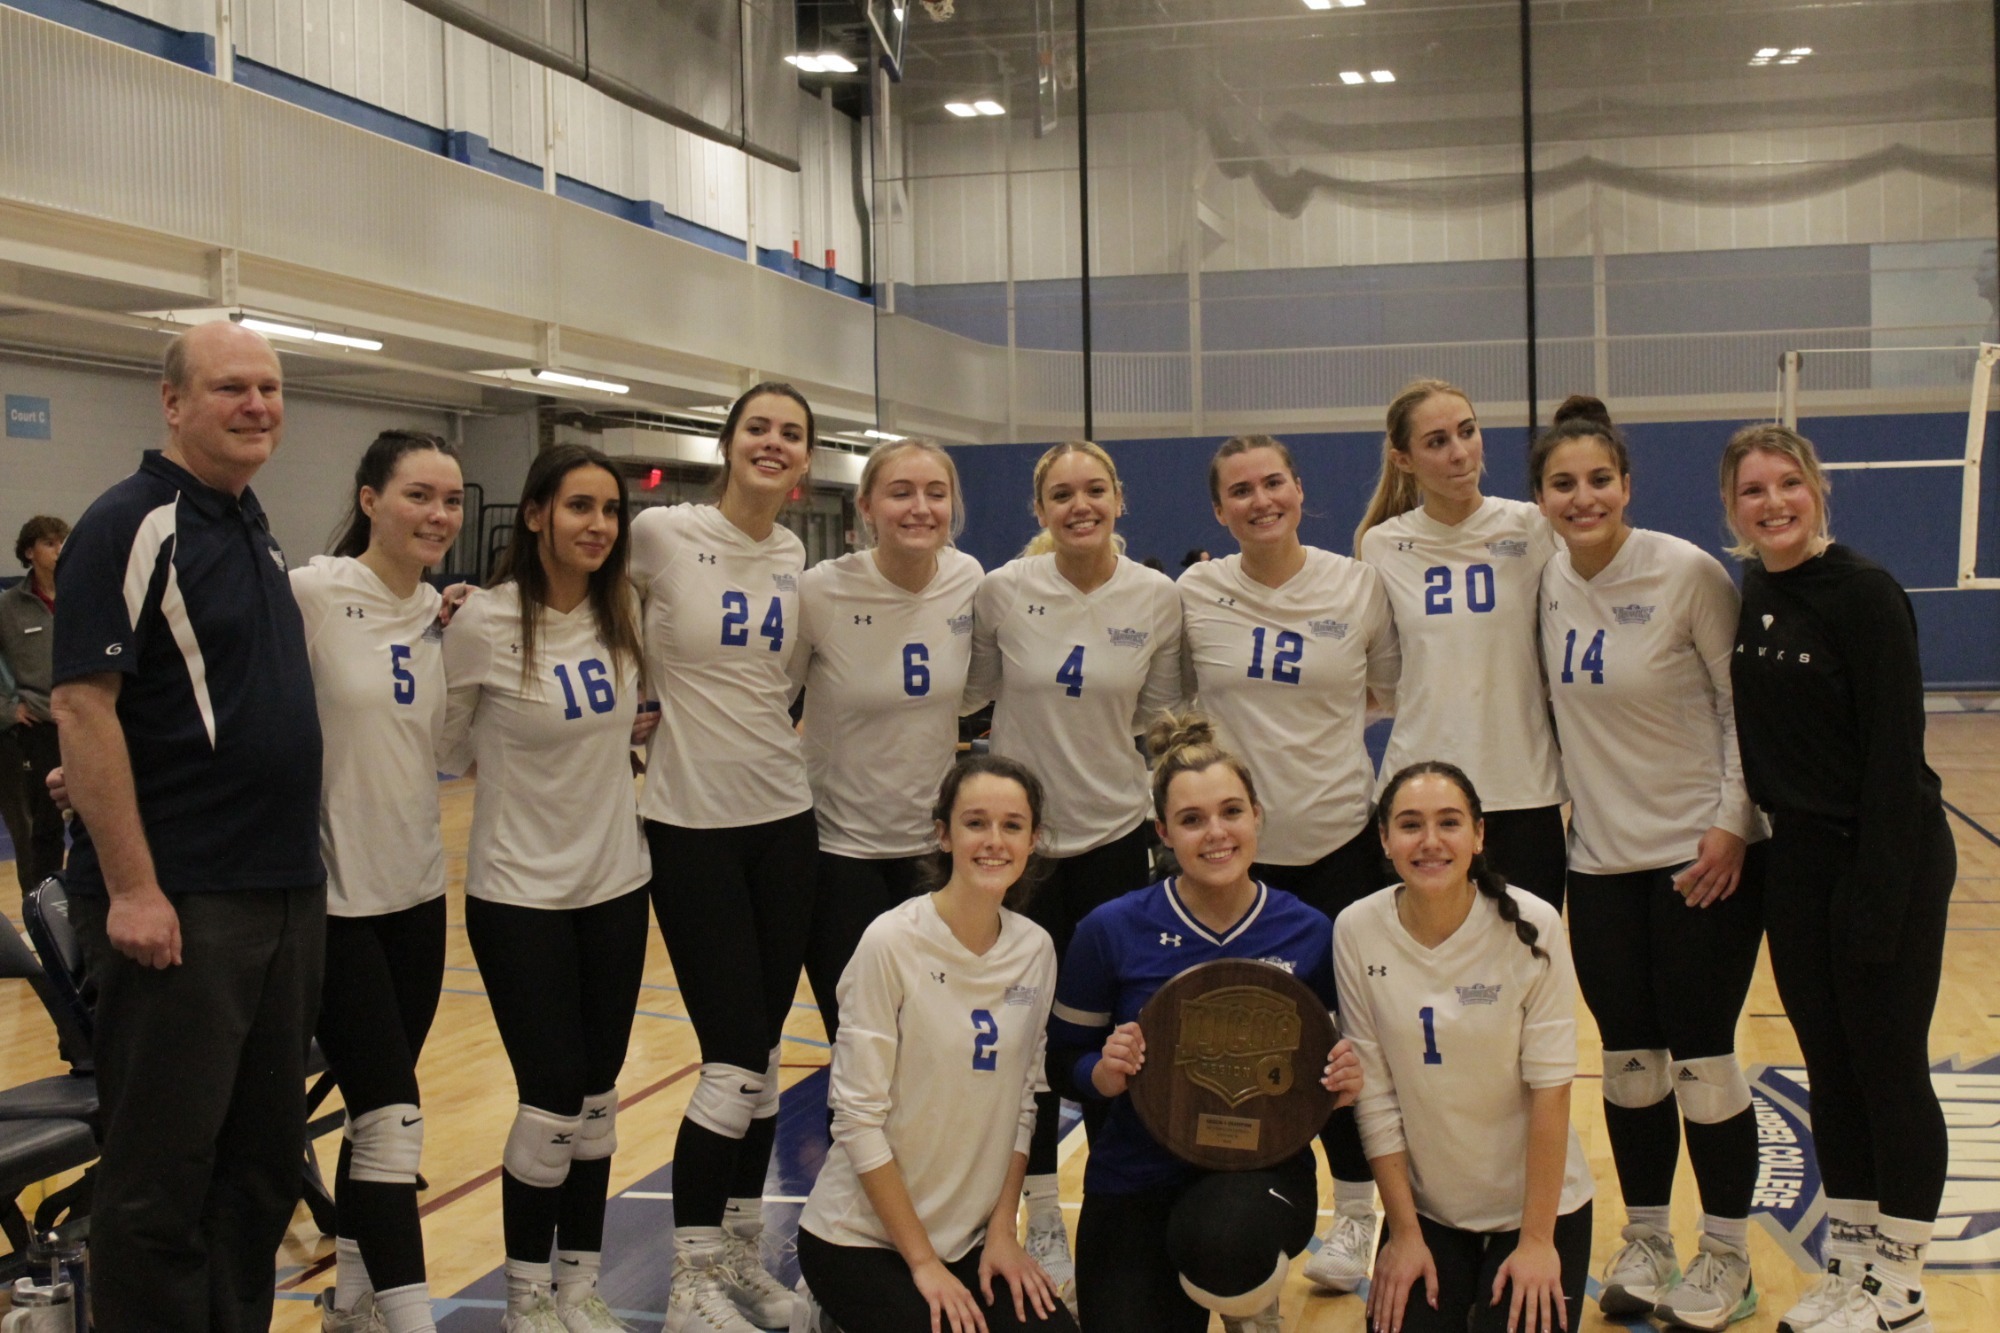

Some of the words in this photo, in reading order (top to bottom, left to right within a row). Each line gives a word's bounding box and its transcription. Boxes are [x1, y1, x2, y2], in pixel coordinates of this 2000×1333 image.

[11, 409, 36, 422] Court
[39, 411, 45, 423] C
[1425, 564, 1495, 615] 20
[721, 591, 785, 652] 24
[391, 645, 415, 704] 5
[903, 643, 930, 696] 6
[1056, 645, 1085, 697] 4
[1247, 627, 1303, 684] 12
[1561, 629, 1605, 684] 14
[554, 658, 615, 720] 16
[971, 1009, 998, 1070] 2
[1419, 1006, 1442, 1064] 1
[1268, 1067, 1281, 1085] 4
[1750, 1145, 1805, 1209] COLLEGE
